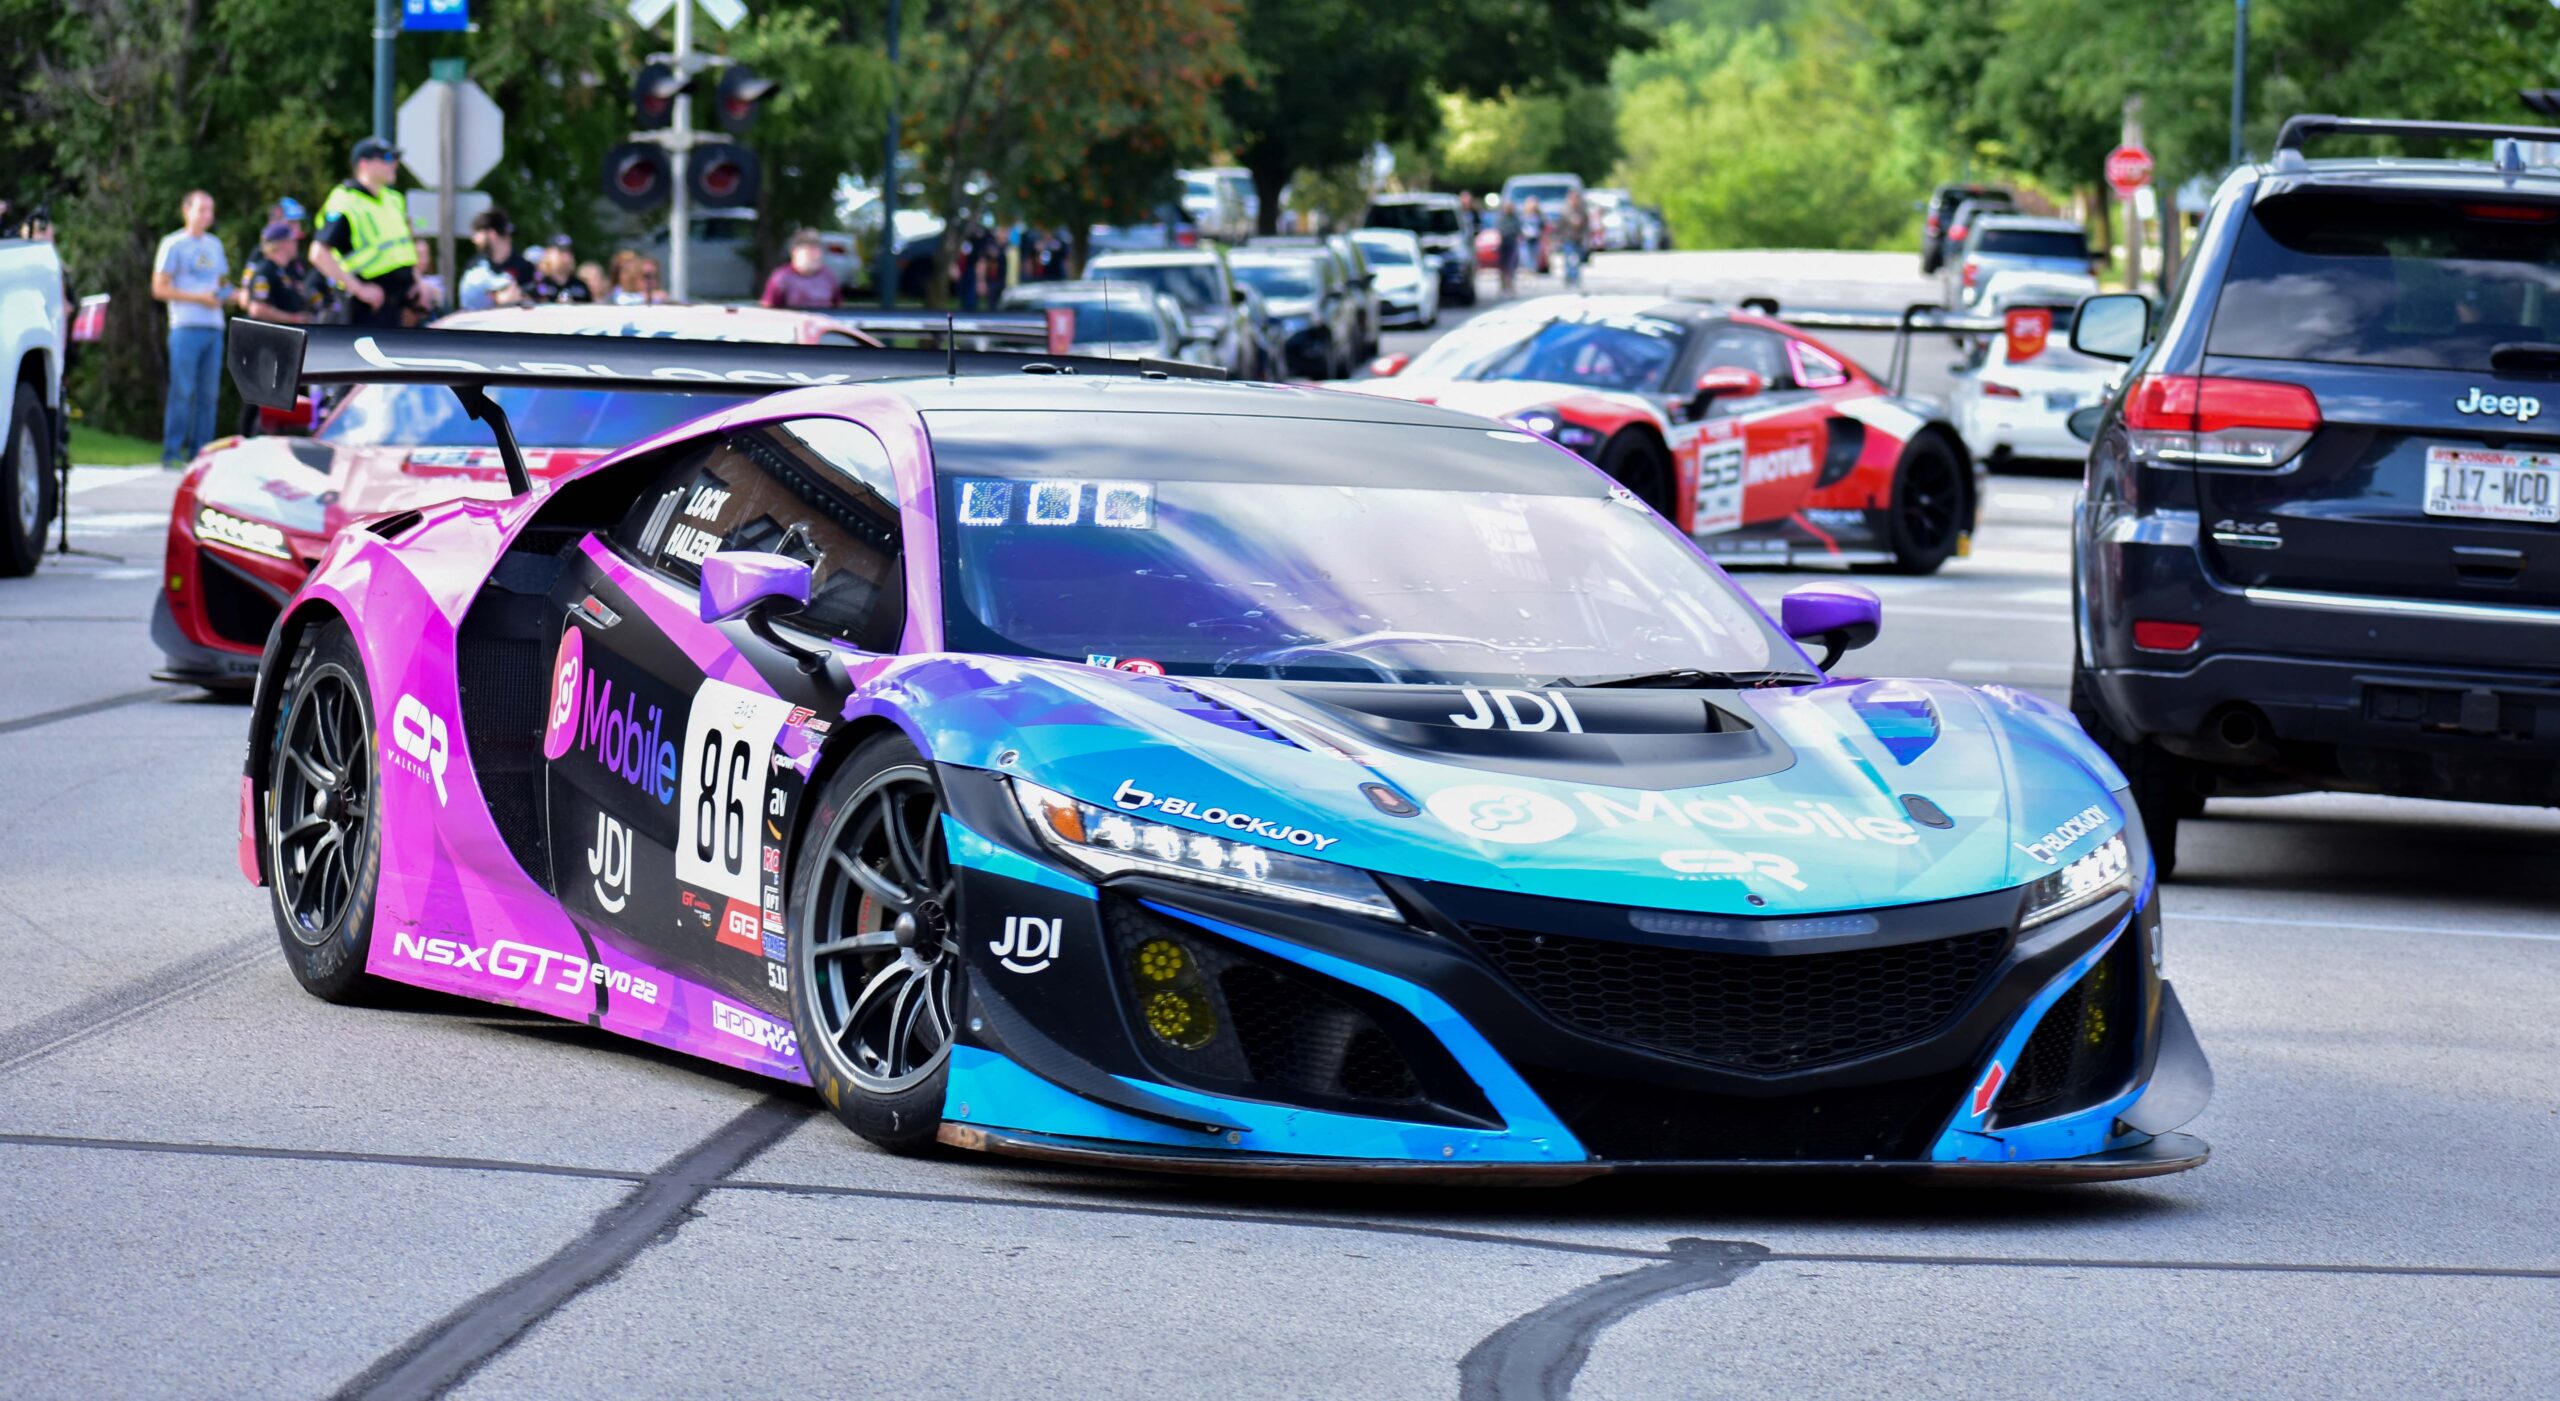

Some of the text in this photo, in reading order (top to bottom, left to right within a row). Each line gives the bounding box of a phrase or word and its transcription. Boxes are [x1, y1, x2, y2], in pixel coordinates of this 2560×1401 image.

[2456, 387, 2541, 421] Jeep
[1703, 449, 1742, 491] 53
[1744, 445, 1814, 487] MOTUL
[2440, 467, 2550, 505] 117-WCD
[684, 485, 731, 522] LOCK
[2213, 519, 2280, 535] 4x4
[785, 706, 816, 728] GT
[1449, 688, 1584, 734] JDI
[581, 668, 677, 806] Mobile
[387, 749, 431, 784] VALKYRIE
[697, 728, 751, 876] 86
[1573, 790, 1921, 846] Mobile
[588, 811, 633, 896] JDI
[729, 909, 759, 941] GT3
[989, 916, 1063, 958] JDI
[714, 1004, 756, 1038] HPD
